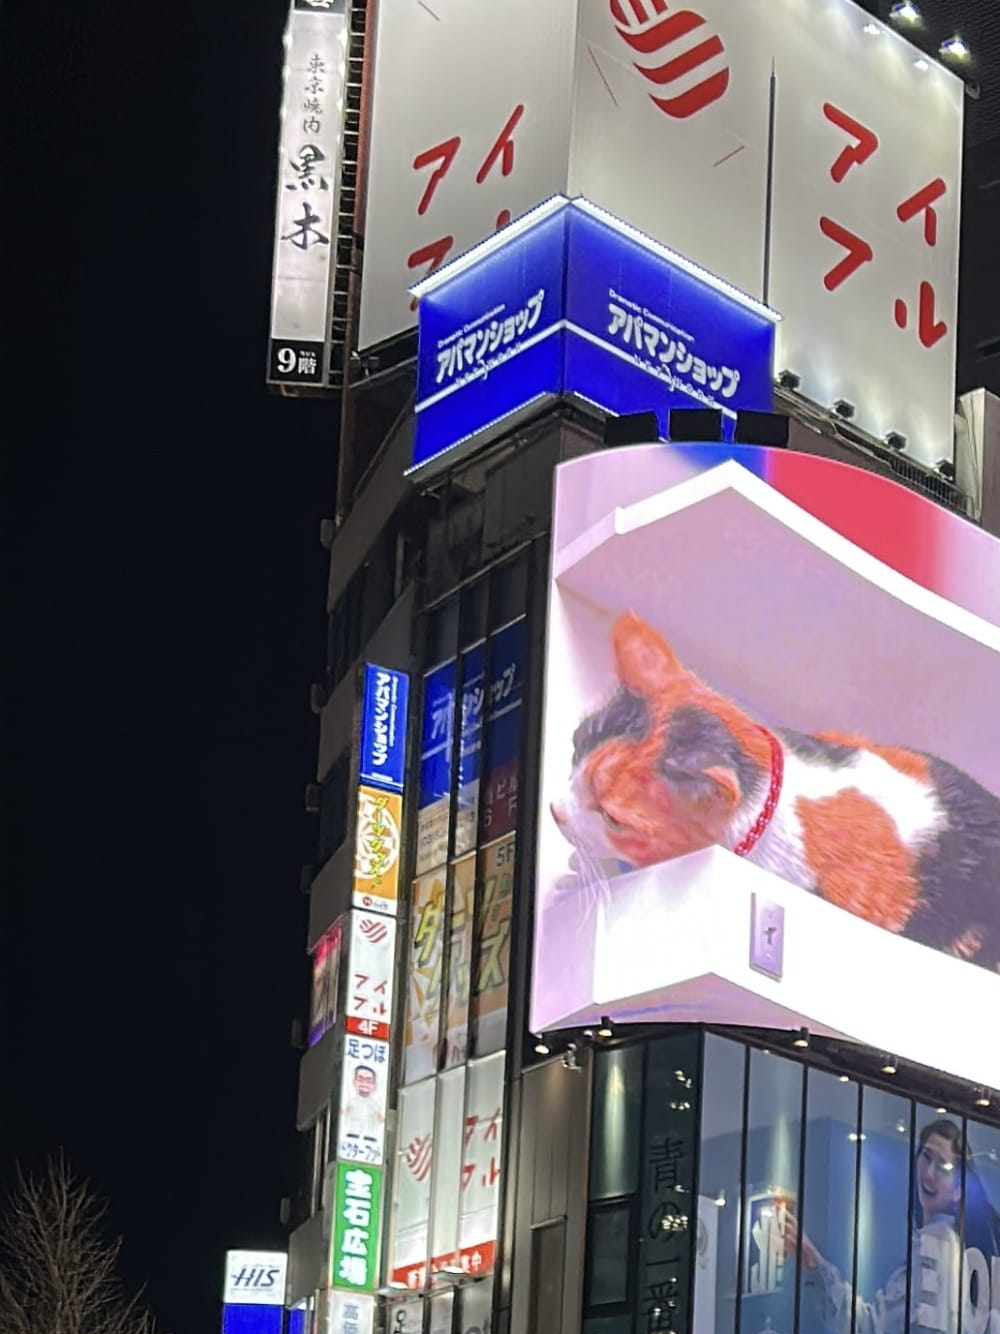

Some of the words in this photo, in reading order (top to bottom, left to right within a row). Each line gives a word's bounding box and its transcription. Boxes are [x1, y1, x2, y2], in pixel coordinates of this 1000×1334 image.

[280, 144, 330, 251] 黒木
[276, 347, 318, 377] 9階
[436, 288, 545, 384] アパマンショップ
[608, 303, 741, 398] アパマンショップ
[357, 1020, 379, 1036] 4F
[339, 1168, 373, 1286] 宝石広場
[231, 1267, 280, 1288] HIS
